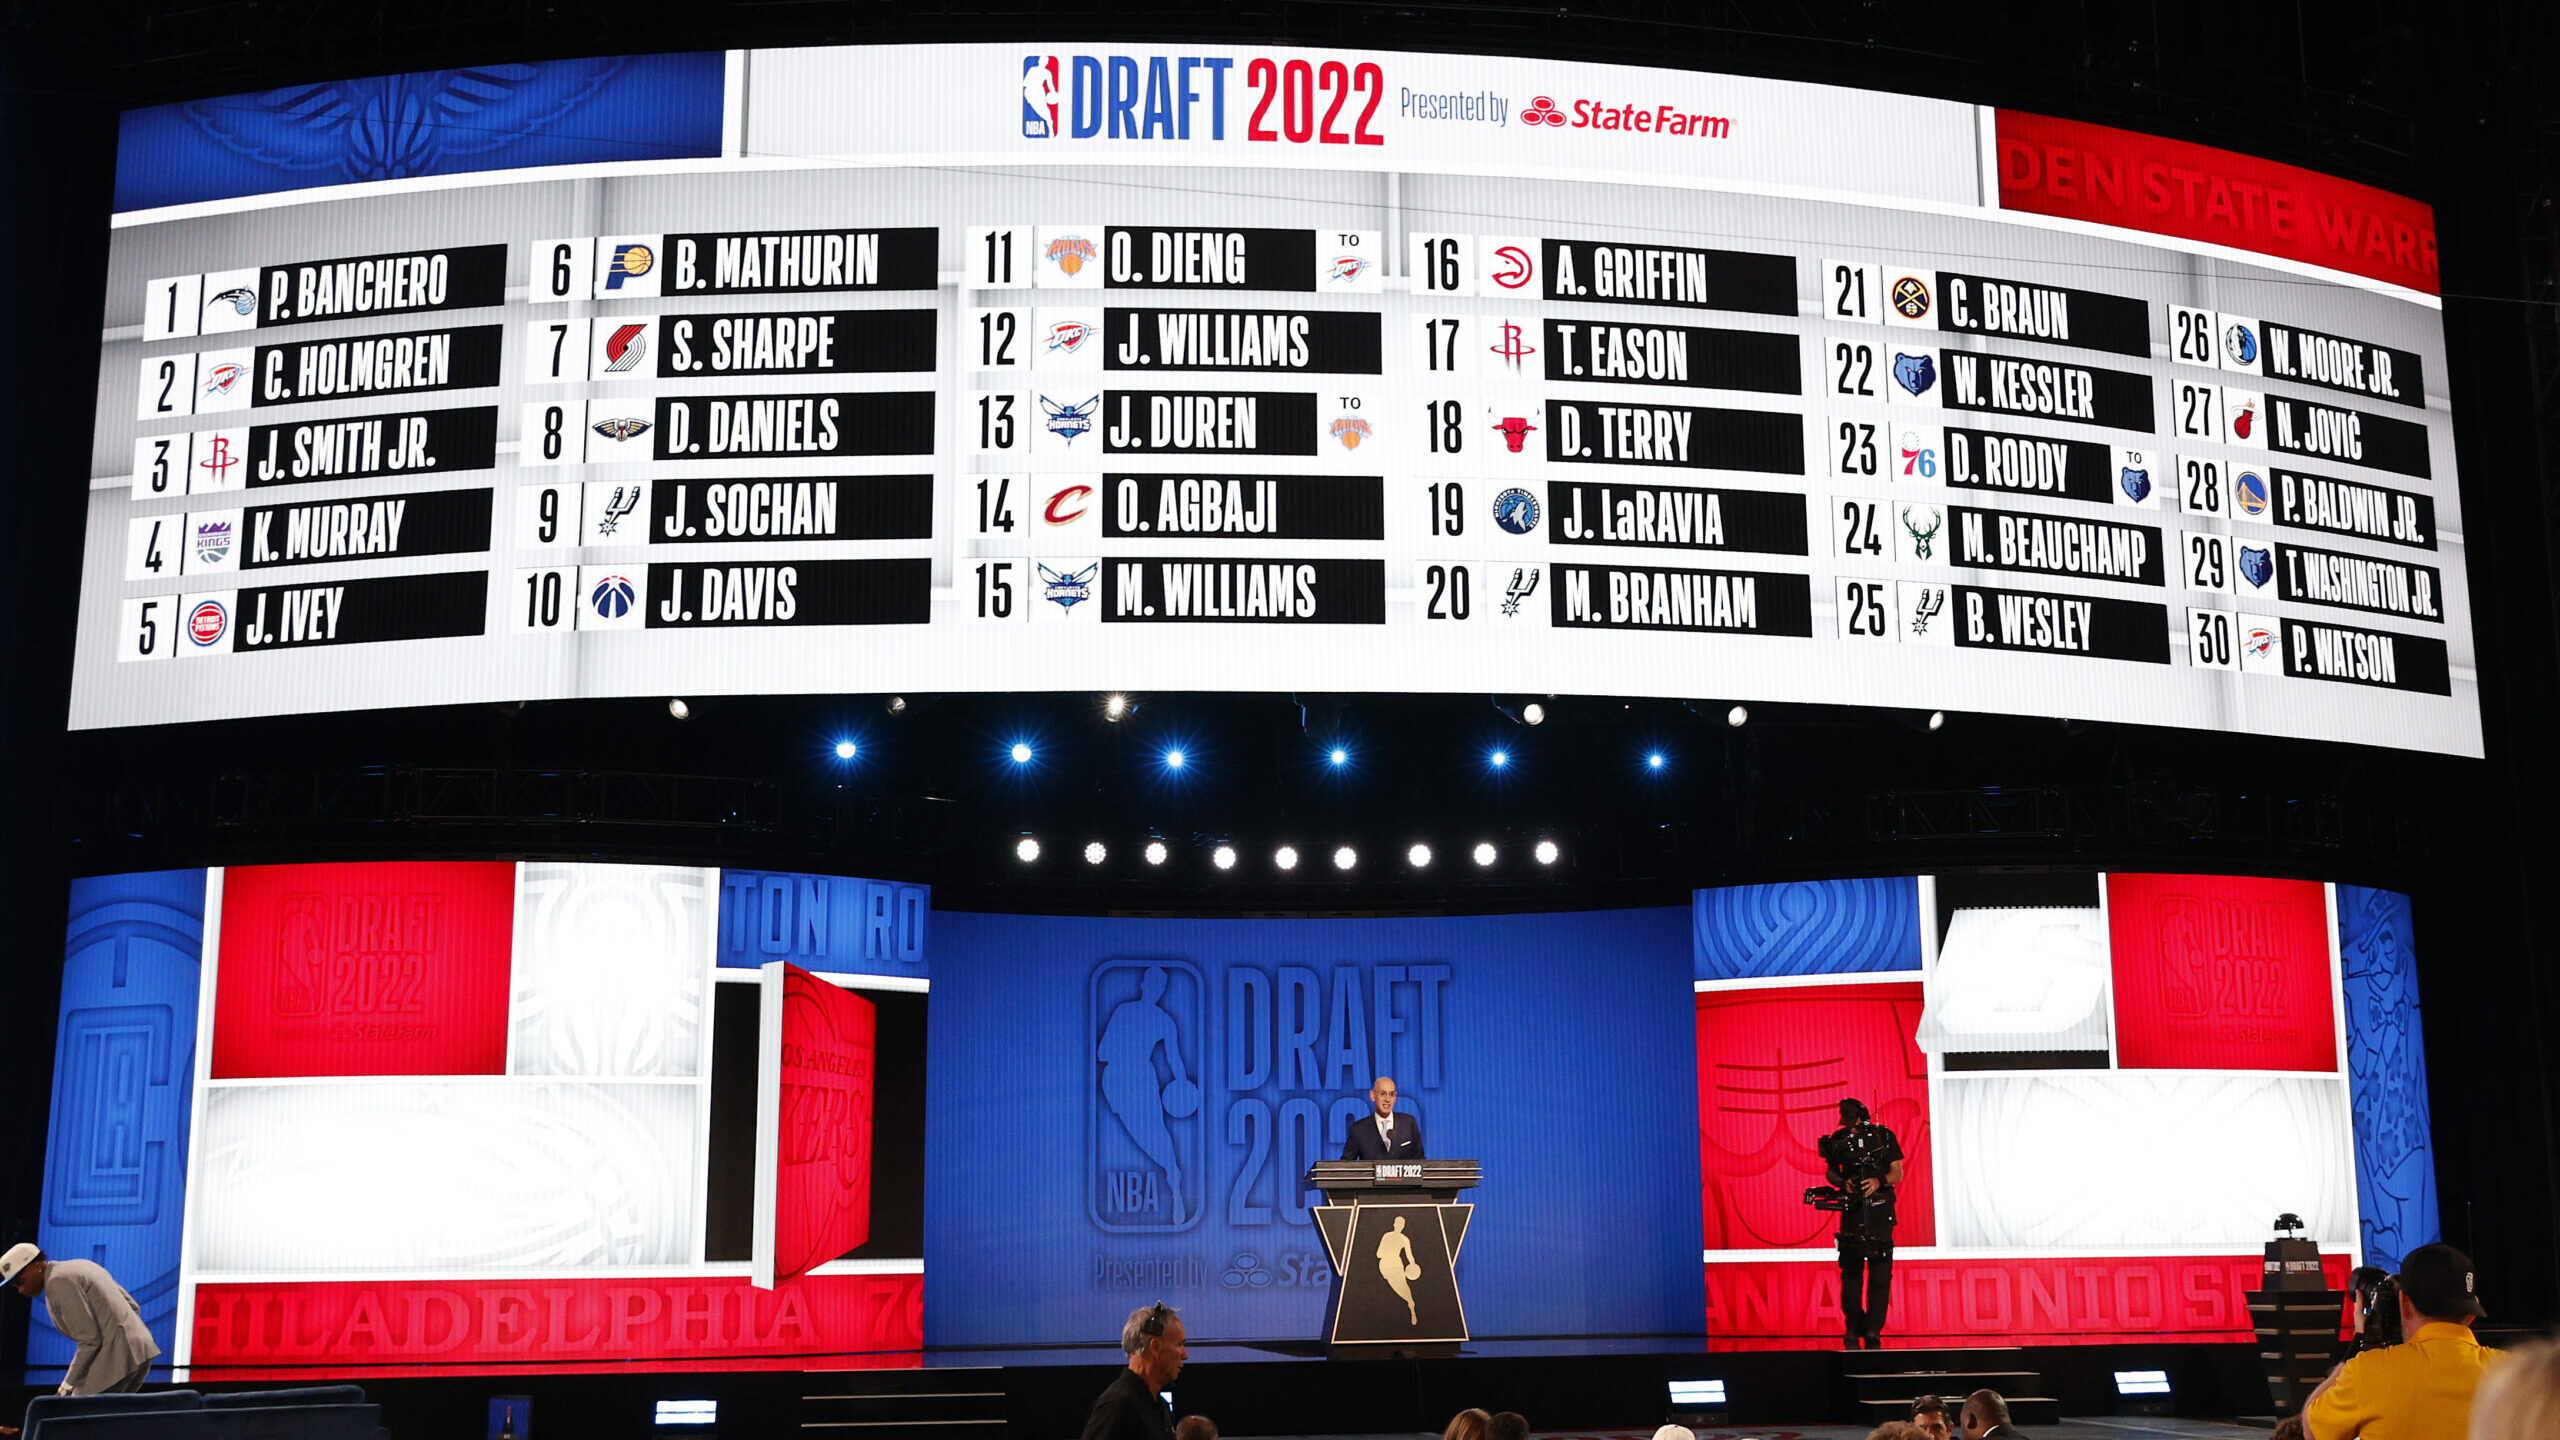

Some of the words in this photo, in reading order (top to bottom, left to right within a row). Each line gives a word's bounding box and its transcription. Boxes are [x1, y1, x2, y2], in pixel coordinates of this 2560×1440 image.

[1026, 121, 1045, 135] NBA
[1071, 56, 1233, 140] DRAFT
[1248, 58, 1384, 145] 2022
[1401, 87, 1485, 121] Presented
[1490, 91, 1508, 127] by
[1998, 137, 2124, 206] DEN
[2142, 162, 2296, 240] STATE
[552, 244, 571, 296] 6
[676, 239, 706, 289] B.
[715, 234, 879, 288] MATHURIN
[985, 231, 1012, 284] 11
[1111, 231, 1143, 283] O.
[1152, 232, 1245, 284] DIENG
[1338, 234, 1359, 246] TO
[1424, 238, 1459, 290] 16
[1556, 245, 1586, 294] A.
[1594, 247, 1707, 303] GRIFFIN
[168, 282, 177, 333] 1
[269, 271, 291, 321] P.
[298, 254, 448, 317] BANCHERO
[1835, 265, 1865, 317] 21
[1951, 279, 1978, 327] C.
[1982, 283, 2069, 340] BRAUN
[550, 325, 568, 376] 7
[672, 320, 702, 371] S.
[712, 316, 835, 369] SHARPE
[980, 312, 1016, 365] 12
[1119, 313, 1151, 365] J.
[1158, 314, 1309, 367] WILLIAMS
[1425, 319, 1459, 371] 17
[1558, 324, 1584, 375] T.
[1590, 326, 1688, 381] EASON
[2178, 311, 2209, 362] 26
[2269, 327, 2296, 376] W.
[2299, 333, 2366, 390] MOORE
[2369, 350, 2399, 397] JR.
[157, 361, 176, 412] 2
[264, 350, 291, 400] C.
[298, 334, 451, 397] HOLMGREN
[1340, 397, 1361, 409] TO
[1836, 343, 1874, 396] 22
[1952, 355, 1986, 406] W.
[1990, 360, 2095, 419] KESSLER
[543, 407, 562, 459] 8
[668, 402, 700, 453] D.
[709, 399, 839, 453] DANIELS
[979, 395, 1014, 449] 13
[1110, 396, 1141, 448] J.
[1151, 397, 1256, 449] DUREN
[1427, 400, 1462, 453] 18
[1560, 406, 1591, 457] D.
[1598, 407, 1692, 462] TERRY
[2183, 385, 2212, 436] 27
[2275, 401, 2300, 450] N.
[2304, 411, 2362, 460] JOVIĆ
[152, 441, 170, 492] 3
[258, 430, 284, 482] J.
[292, 420, 385, 478] SMITH
[388, 417, 436, 470] JR.
[1840, 423, 1876, 475] 23
[1951, 433, 1979, 483] D.
[1985, 436, 2067, 492] RODDY
[1901, 446, 1936, 478] 76
[2126, 451, 2142, 464] TO
[539, 489, 559, 542] 9
[665, 486, 696, 537] J.
[705, 482, 837, 536] SOCHAN
[977, 479, 1014, 532] 14
[1117, 479, 1149, 532] O.
[1157, 480, 1277, 532] AGBAJI
[1428, 483, 1464, 536] 19
[1563, 488, 1594, 539] J.
[1602, 489, 1724, 545] LaRAVIA
[2187, 460, 2219, 512] 28
[2281, 475, 2300, 523] P.
[2303, 480, 2389, 538] BALDWIN
[2393, 496, 2424, 543] JR.
[145, 521, 162, 573] 4
[252, 511, 279, 563] K.
[286, 500, 405, 560] MURRAY
[197, 537, 231, 548] KINGS
[1844, 502, 1881, 556] 24
[1962, 513, 1993, 563] M.
[1999, 516, 2147, 578] BEAUCHAMP
[527, 572, 562, 627] 10
[661, 569, 692, 621] J.
[702, 566, 797, 621] DAVIS
[976, 563, 1012, 618] 15
[1117, 563, 1155, 616] M.
[1162, 564, 1316, 618] WILLIAMS
[1427, 566, 1469, 620] 20
[1565, 569, 1602, 622] M.
[1608, 572, 1756, 628] BRANHAM
[2192, 536, 2224, 588] 29
[2285, 550, 2302, 597] T.
[2303, 552, 2409, 612] WASHINGTON
[2412, 567, 2438, 617] JR.
[139, 602, 157, 655] 5
[246, 592, 273, 645] J.
[280, 586, 344, 642] IVEY
[1847, 582, 1885, 636] 25
[1967, 592, 1995, 643] B.
[1998, 595, 2092, 651] WESLEY
[2197, 613, 2230, 665] 30
[2293, 626, 2312, 673] P.
[2314, 628, 2396, 684] WATSON
[337, 895, 442, 952] DRAFT
[724, 874, 827, 956] TON
[866, 883, 924, 963] RO
[2211, 900, 2291, 958] DRAFT
[334, 955, 425, 1012] 2022
[2215, 958, 2287, 1016] 2022
[1228, 965, 1451, 1090] DRAFT
[781, 1043, 802, 1067] OS
[806, 1049, 867, 1078] ANGELES
[1107, 1171, 1159, 1214] NBA
[1382, 1165, 1403, 1177] DRAFT
[1404, 1165, 1421, 1177] 2022
[1095, 1254, 1184, 1289] Presented
[1189, 1255, 1208, 1291] by
